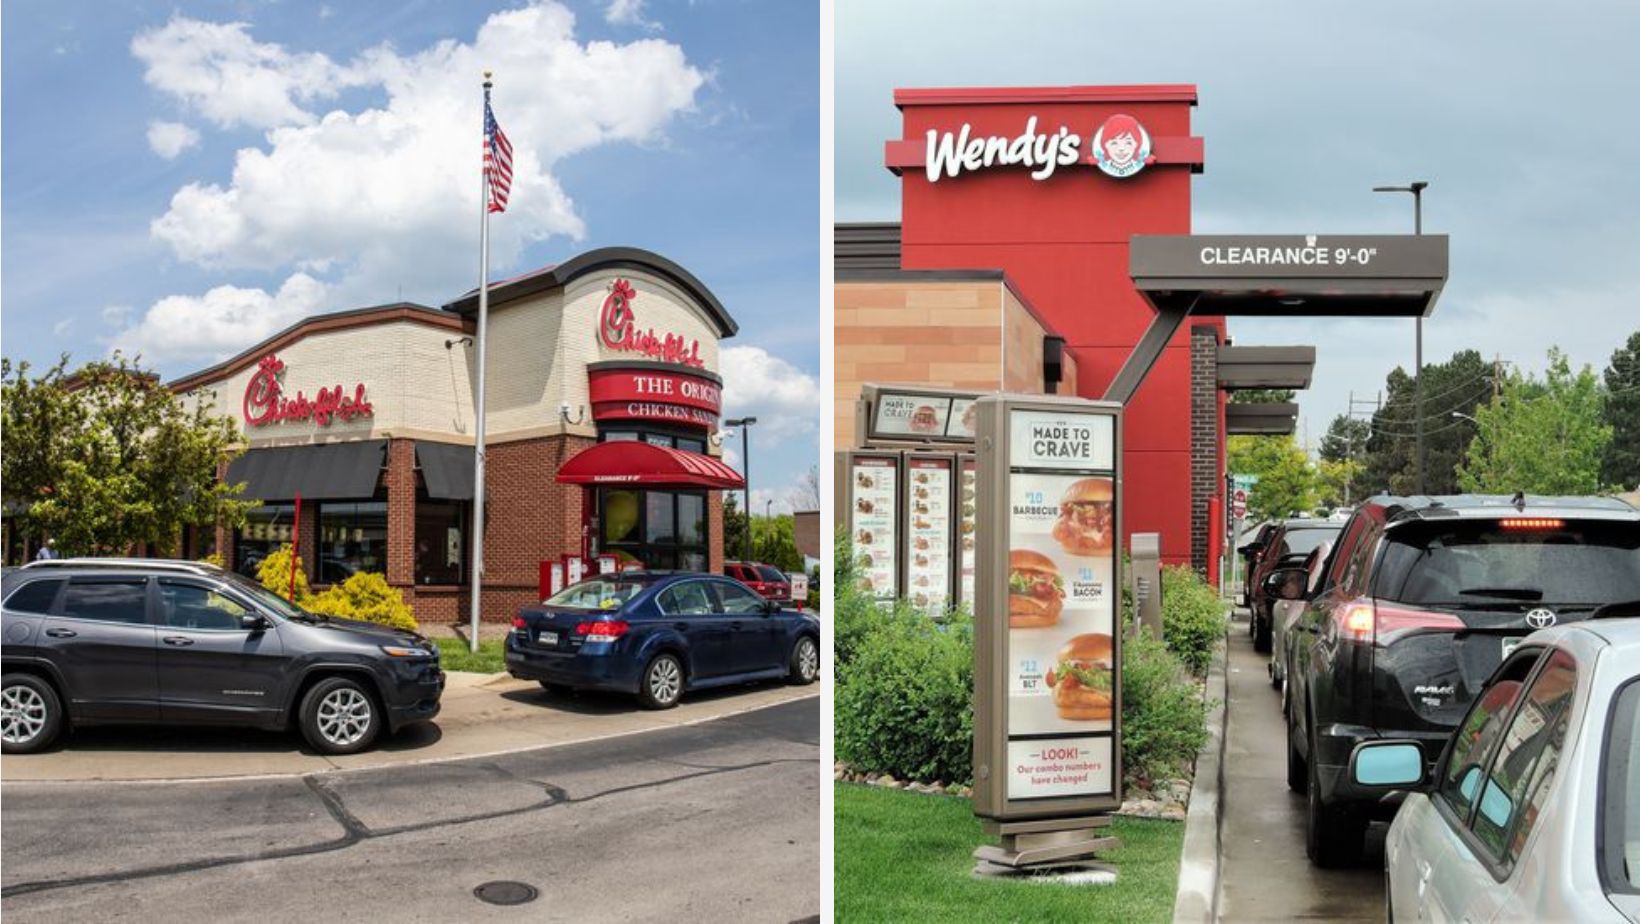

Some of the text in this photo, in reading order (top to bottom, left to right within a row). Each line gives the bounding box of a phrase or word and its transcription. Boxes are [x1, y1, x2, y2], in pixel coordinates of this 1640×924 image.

[925, 115, 1080, 183] Wendy's
[1200, 247, 1329, 265] CLEARANCE
[633, 375, 674, 396] THE
[627, 402, 690, 420] CHICKEN
[1033, 427, 1090, 441] MADE TO
[1033, 440, 1090, 458] CRAVE
[1013, 506, 1058, 516] BARBECUE
[1073, 588, 1102, 597] BACON
[1023, 680, 1037, 688] BLT
[1041, 748, 1078, 760] LOOK!
[1017, 761, 1102, 774] Our combo numbers
[1031, 773, 1088, 785] have changed
